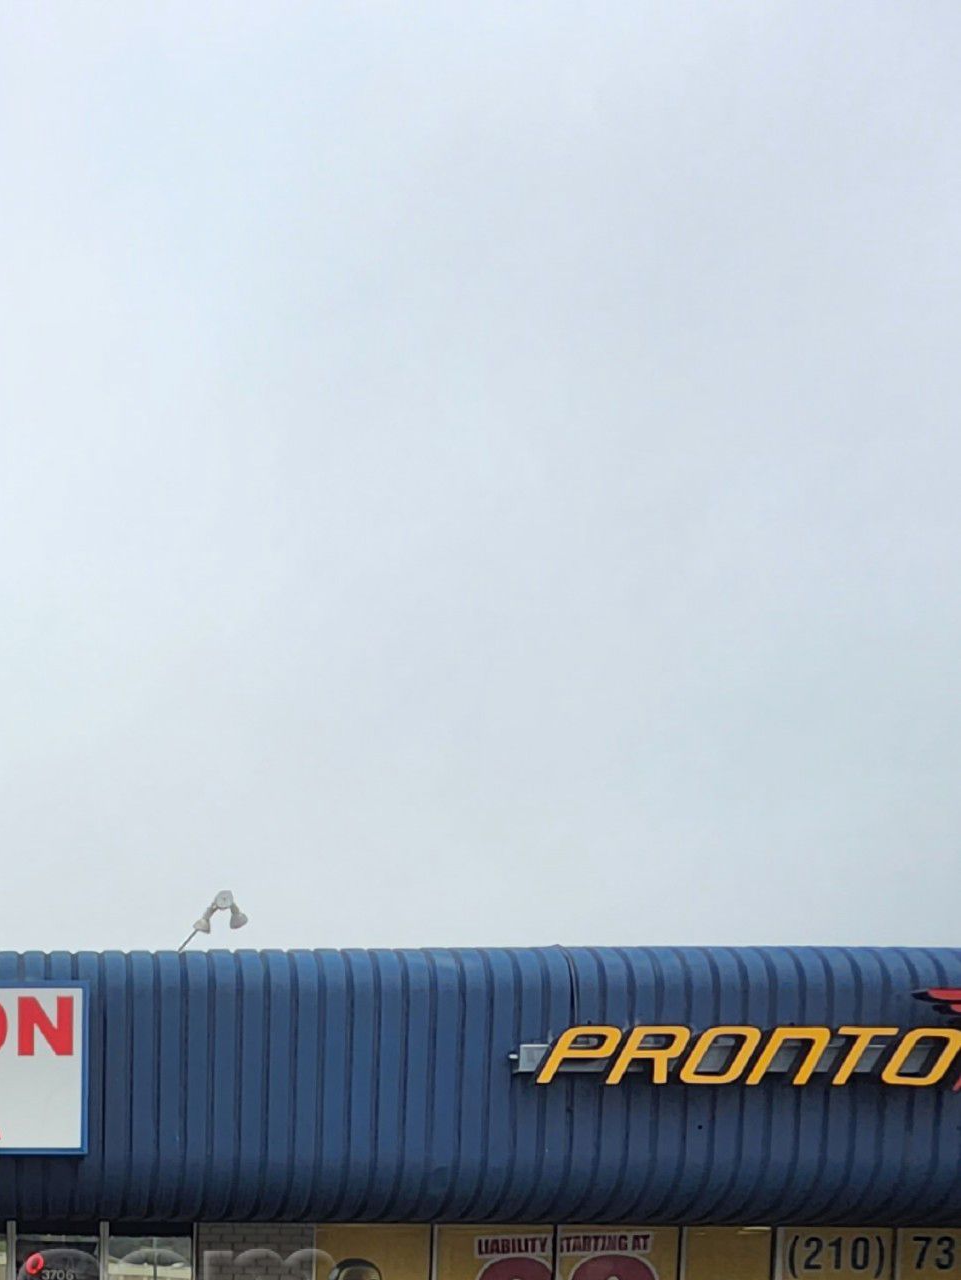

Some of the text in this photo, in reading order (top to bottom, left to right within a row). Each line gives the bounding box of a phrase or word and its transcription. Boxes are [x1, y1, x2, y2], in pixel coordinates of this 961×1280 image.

[536, 1026, 961, 1086] PRONTO
[478, 1237, 547, 1255] LIABILITY
[632, 1235, 650, 1250] AT
[788, 1235, 955, 1279] (210) 73
[41, 1269, 74, 1280] 3706
